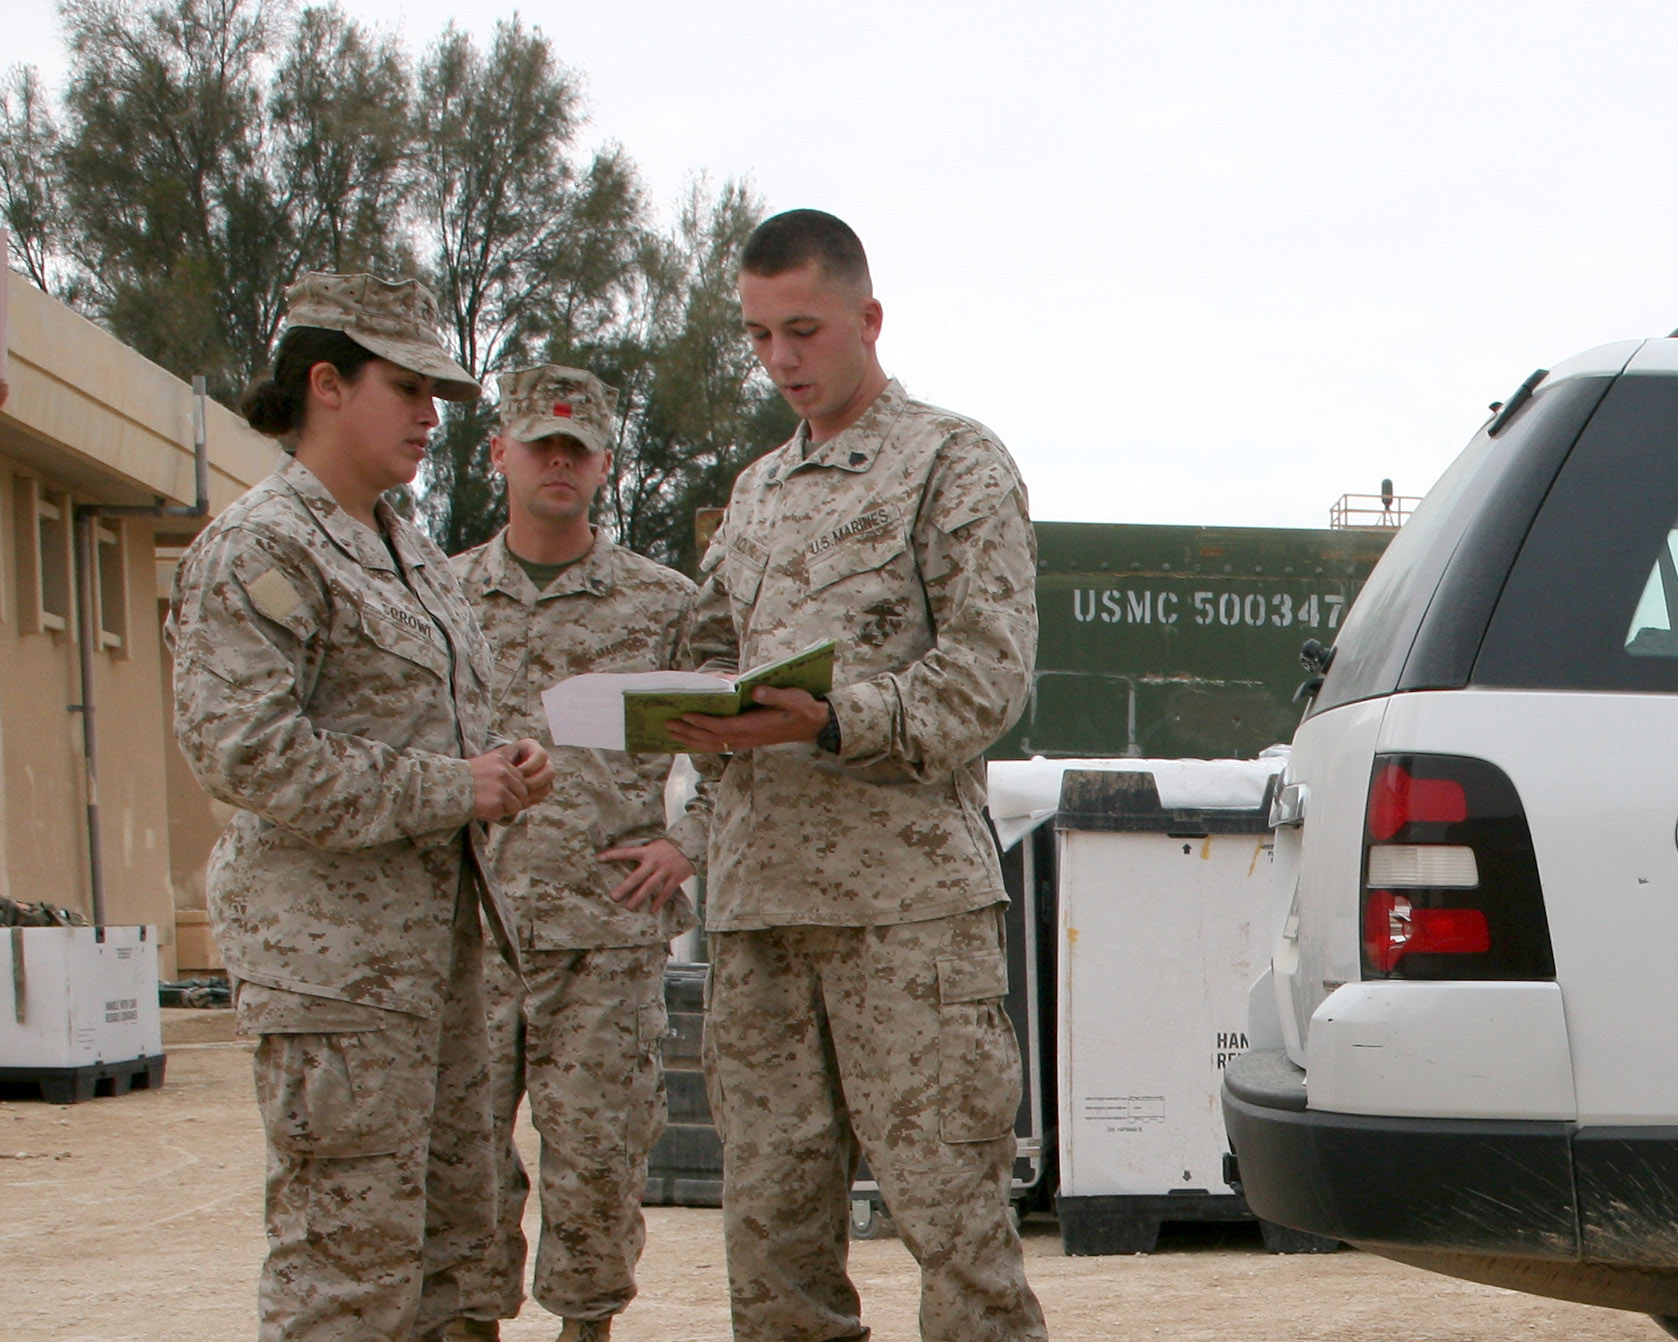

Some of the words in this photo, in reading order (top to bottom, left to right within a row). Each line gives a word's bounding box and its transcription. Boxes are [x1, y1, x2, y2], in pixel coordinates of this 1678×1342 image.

[832, 509, 889, 545] MARINES
[1073, 588, 1179, 624] USMC
[1194, 591, 1345, 628] 500347
